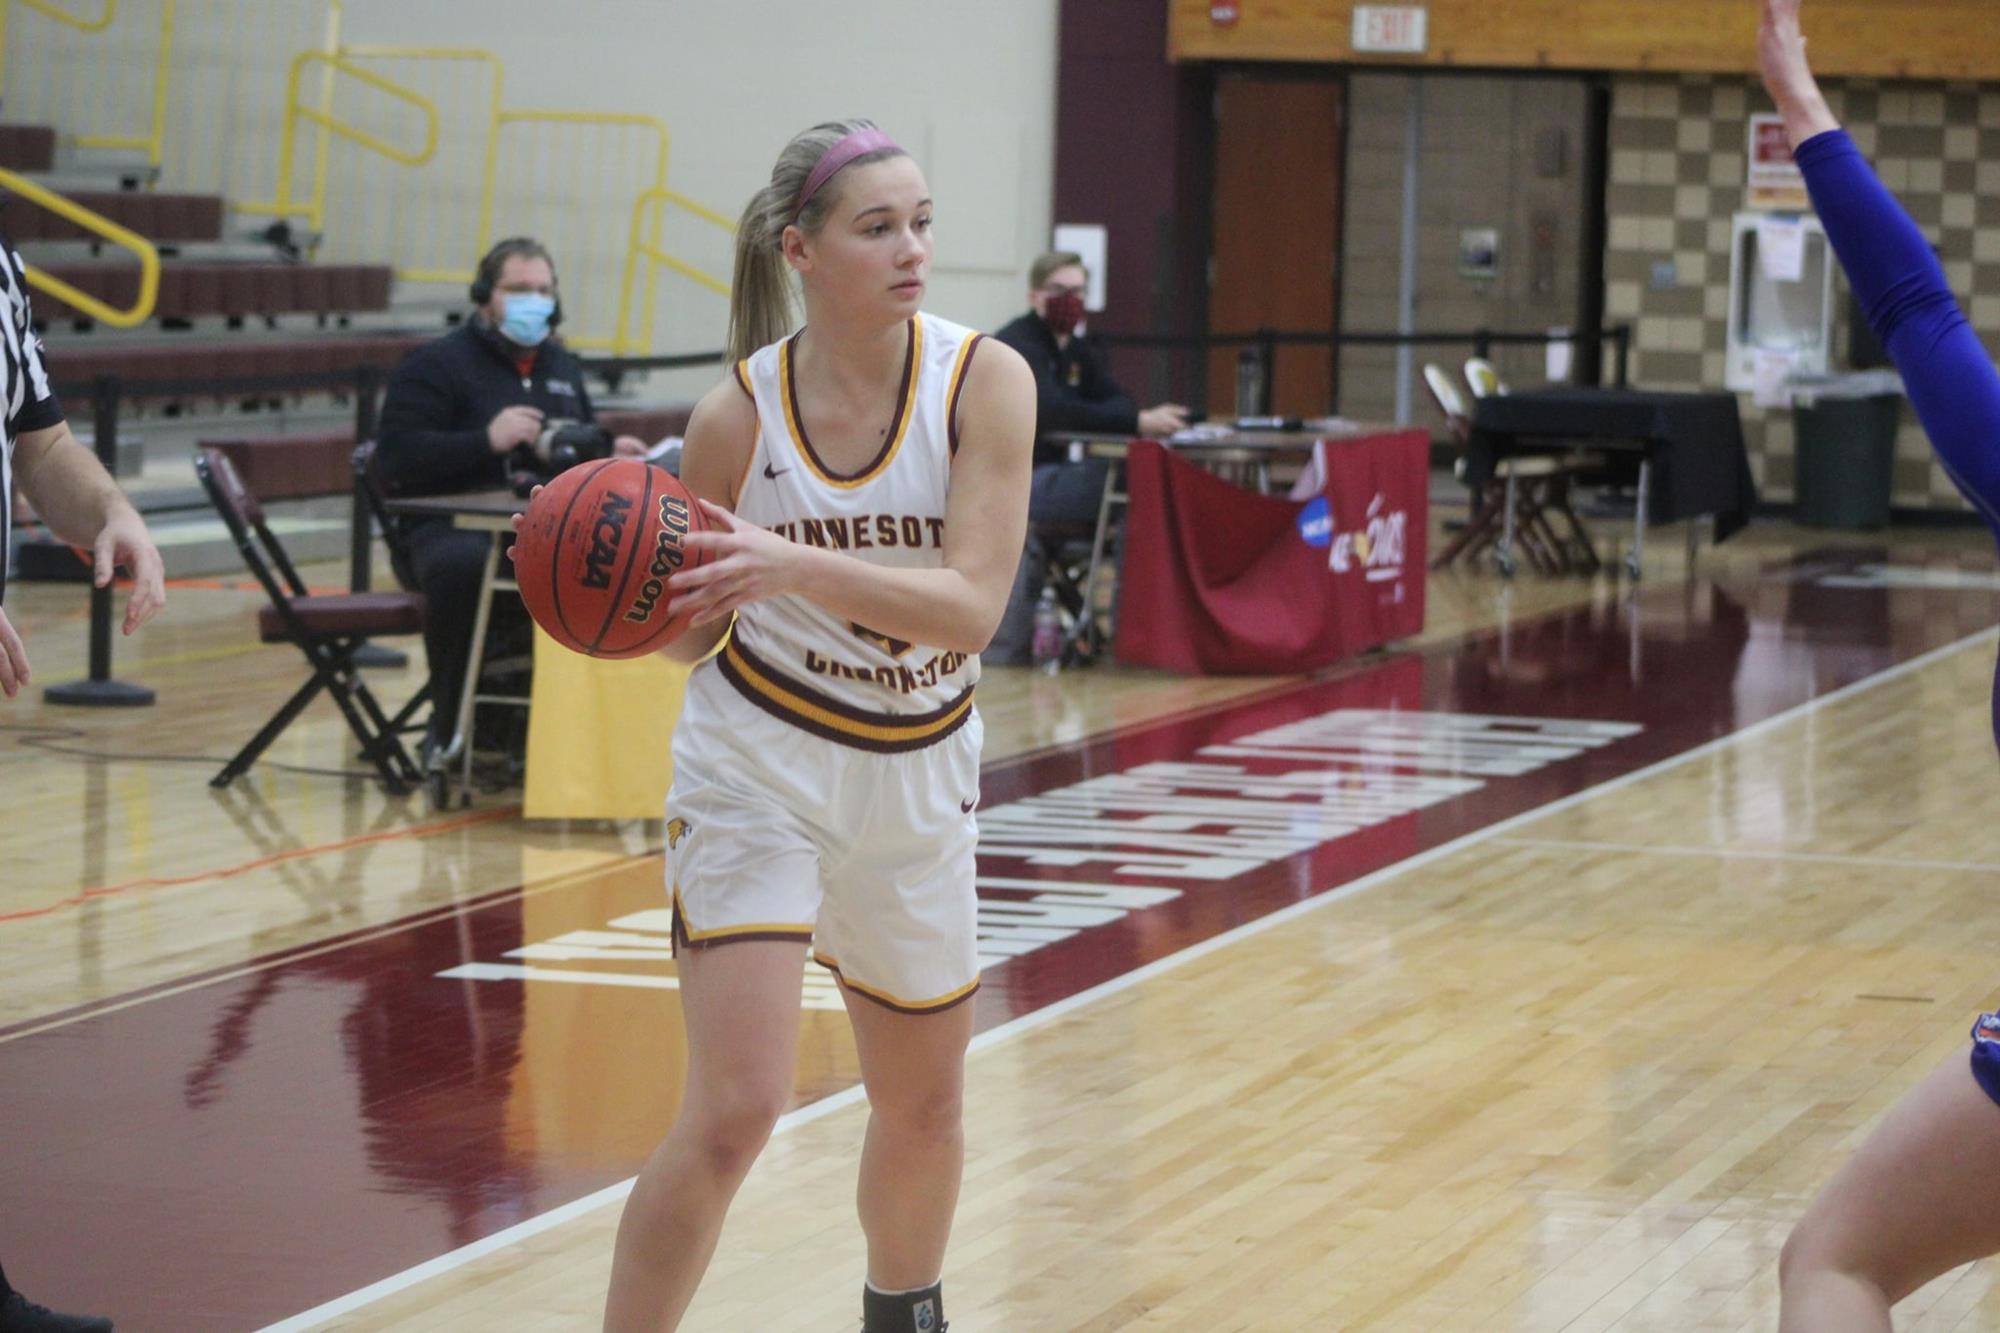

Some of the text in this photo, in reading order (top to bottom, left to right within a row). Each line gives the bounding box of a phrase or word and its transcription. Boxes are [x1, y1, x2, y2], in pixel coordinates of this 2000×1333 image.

[1366, 9, 1413, 45] EXIT
[580, 490, 634, 591] NCAA
[764, 513, 945, 550] INNESOT
